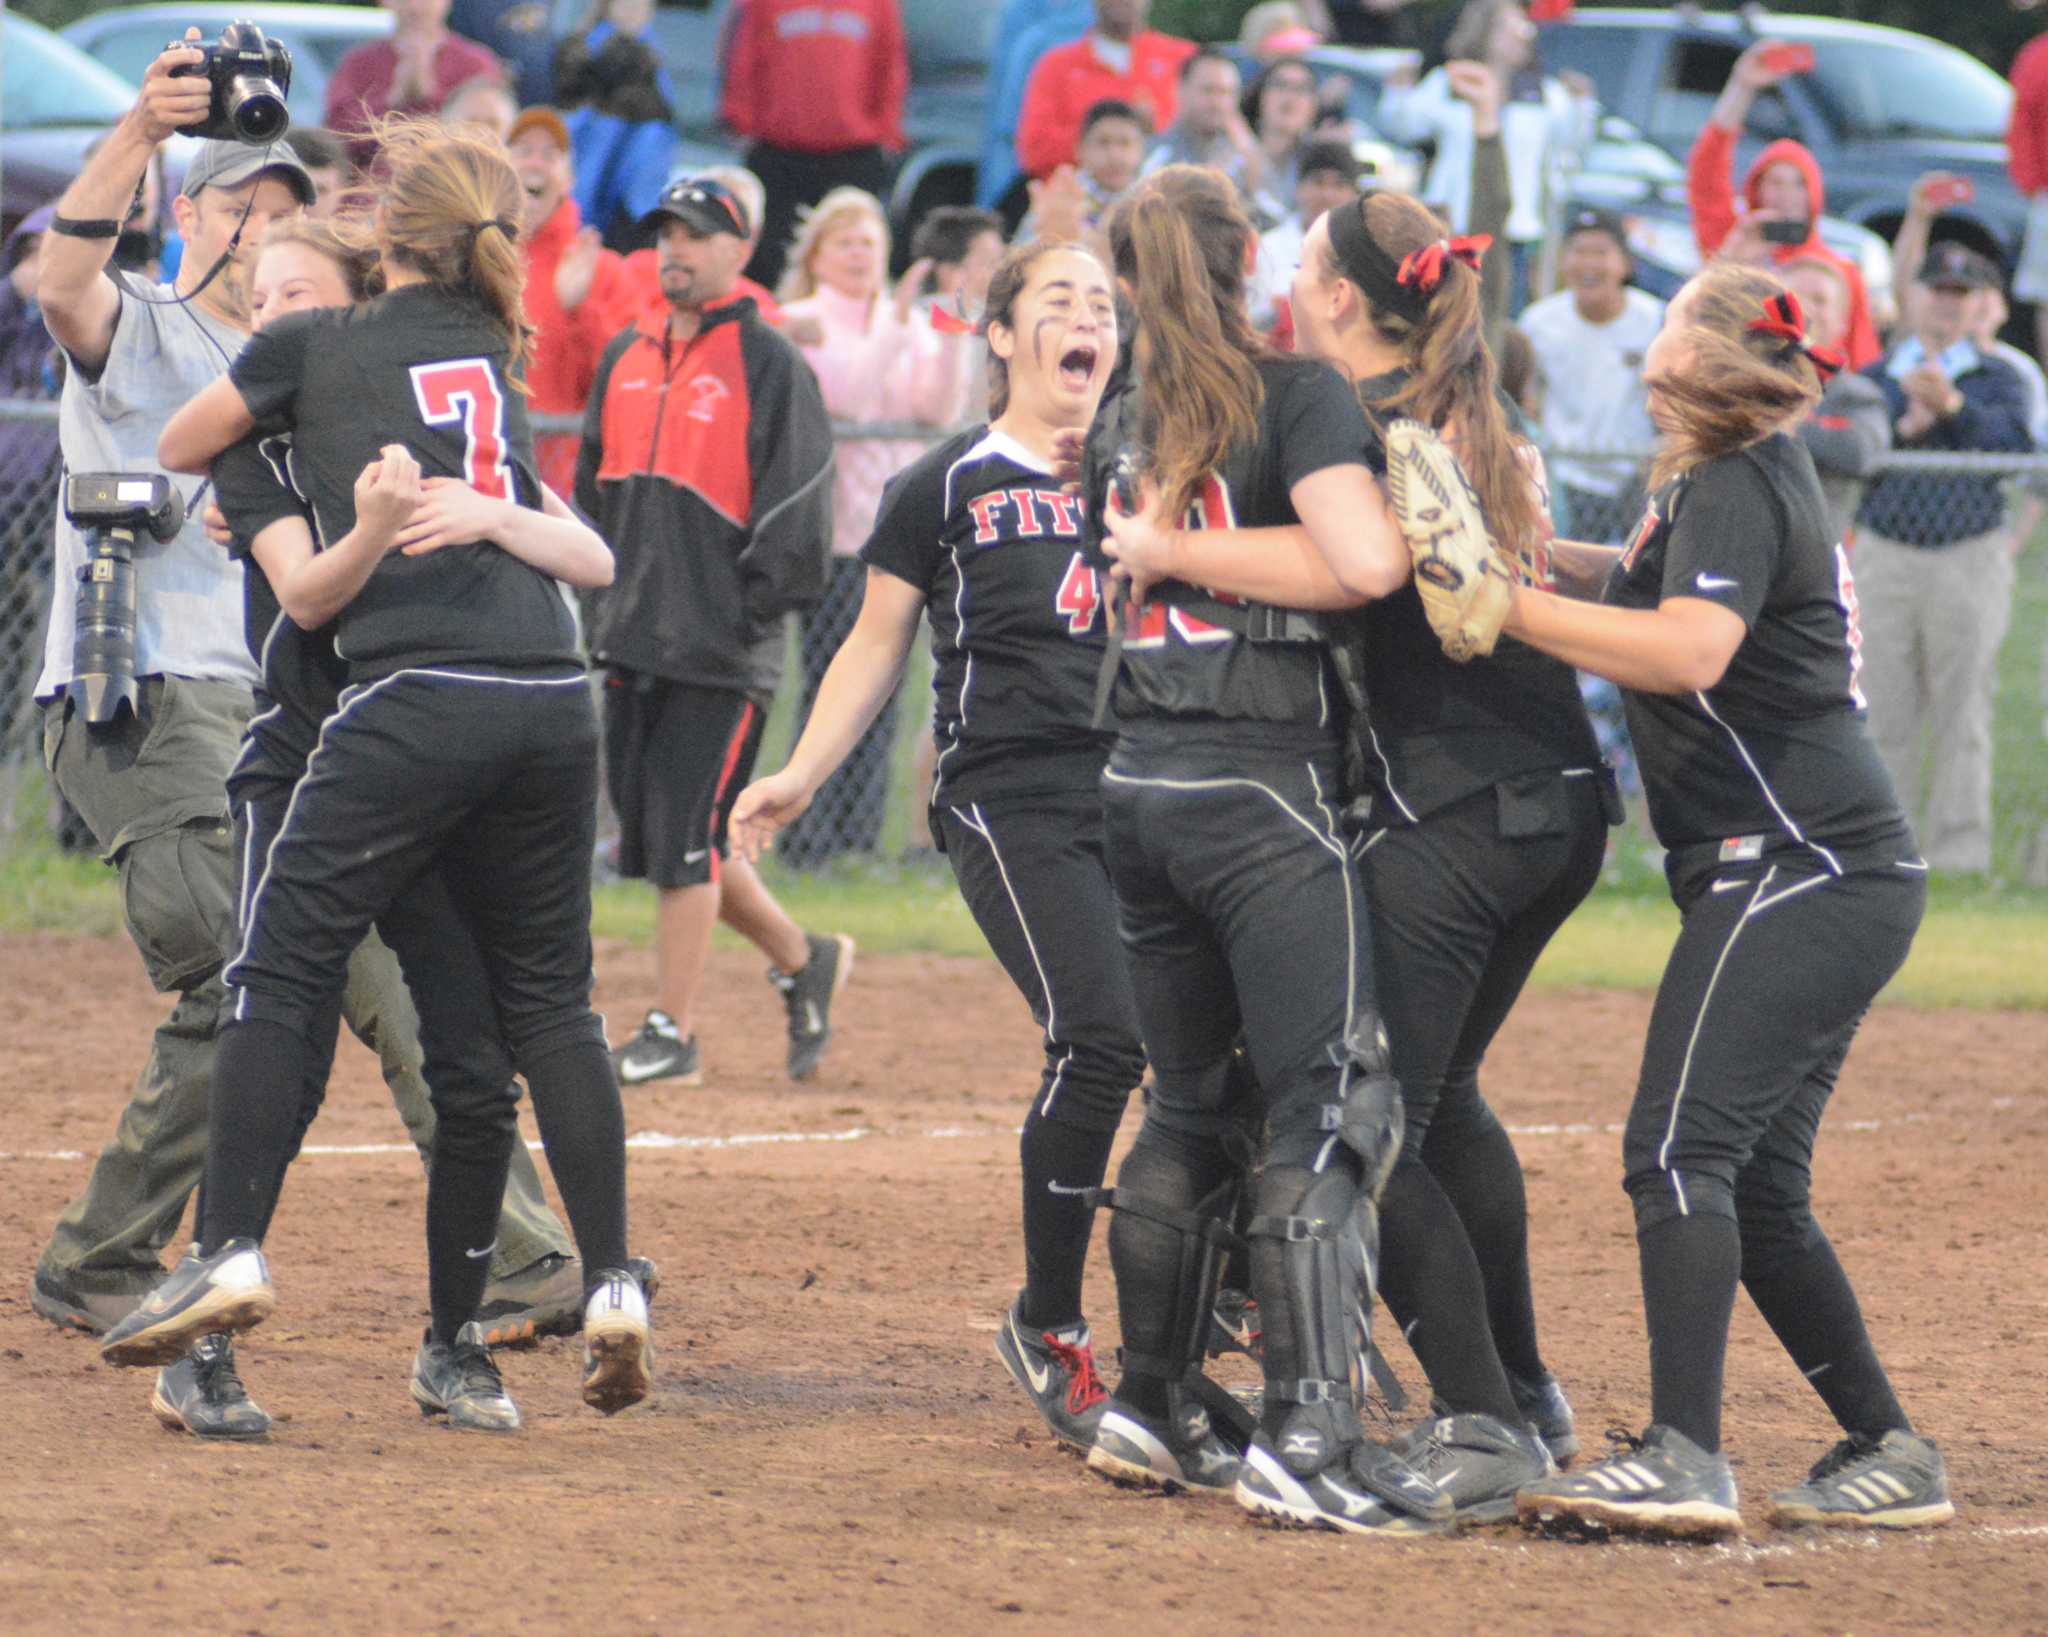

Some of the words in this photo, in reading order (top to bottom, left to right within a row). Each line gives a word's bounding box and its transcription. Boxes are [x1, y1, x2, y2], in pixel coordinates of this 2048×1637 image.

[408, 358, 516, 504] 7
[967, 488, 1085, 544] FIT
[1056, 551, 1101, 634] 4
